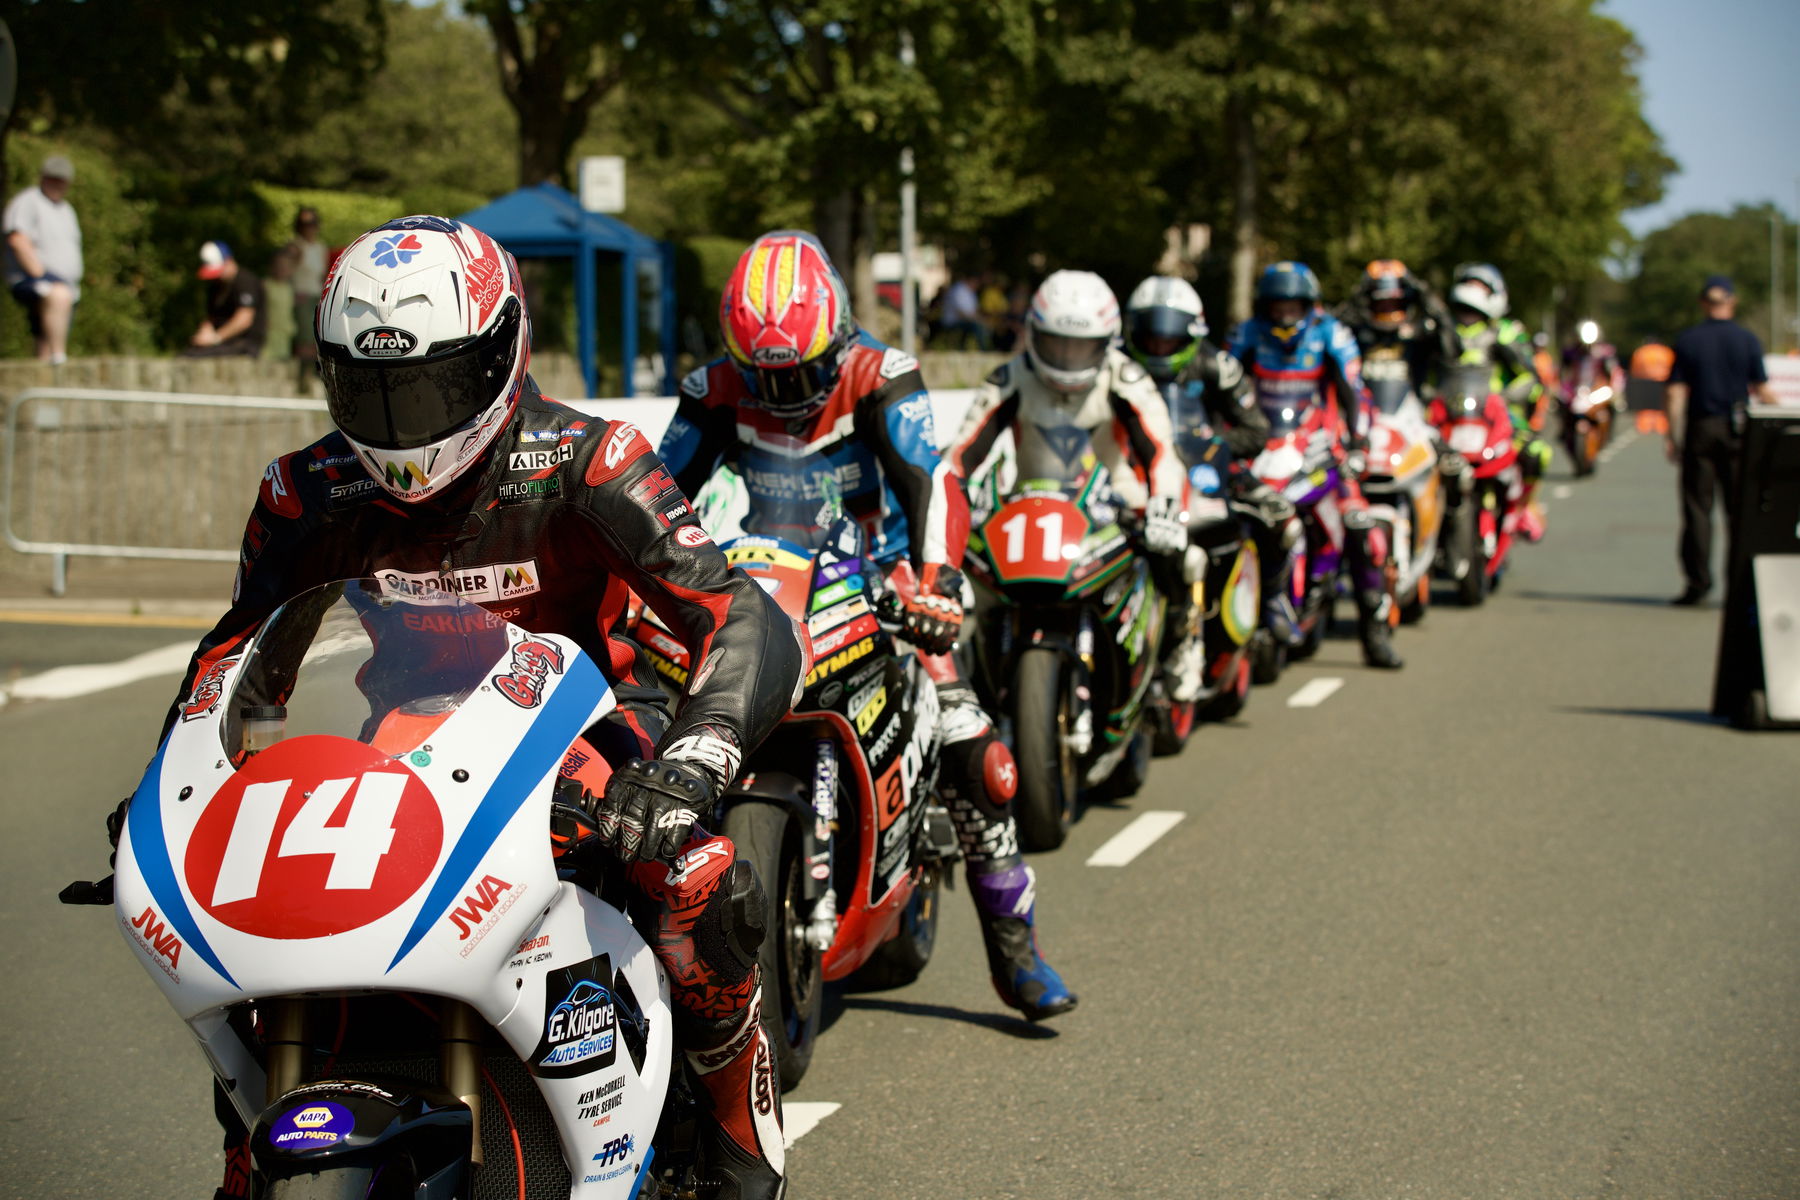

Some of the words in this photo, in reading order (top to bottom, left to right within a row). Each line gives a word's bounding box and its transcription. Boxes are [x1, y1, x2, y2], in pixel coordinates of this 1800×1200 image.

[479, 267, 504, 311] TOOLS
[360, 331, 411, 350] Airoh
[756, 347, 797, 363] Arai
[512, 445, 572, 469] AIROH
[1002, 512, 1063, 563] 11
[384, 574, 489, 597] GARDINER
[503, 585, 536, 597] CAMPSIE
[211, 772, 410, 907] 14
[448, 874, 513, 941] JWA
[131, 906, 183, 970] JWA
[577, 1089, 596, 1105] KEN
[578, 1104, 601, 1119] TYRE
[601, 1092, 623, 1114] SERVICE
[299, 1112, 327, 1122] NAPA
[276, 1131, 304, 1142] AUTO
[304, 1131, 338, 1141] PARTS
[600, 1133, 629, 1168] TPS
[584, 1173, 602, 1183] DRAIN
